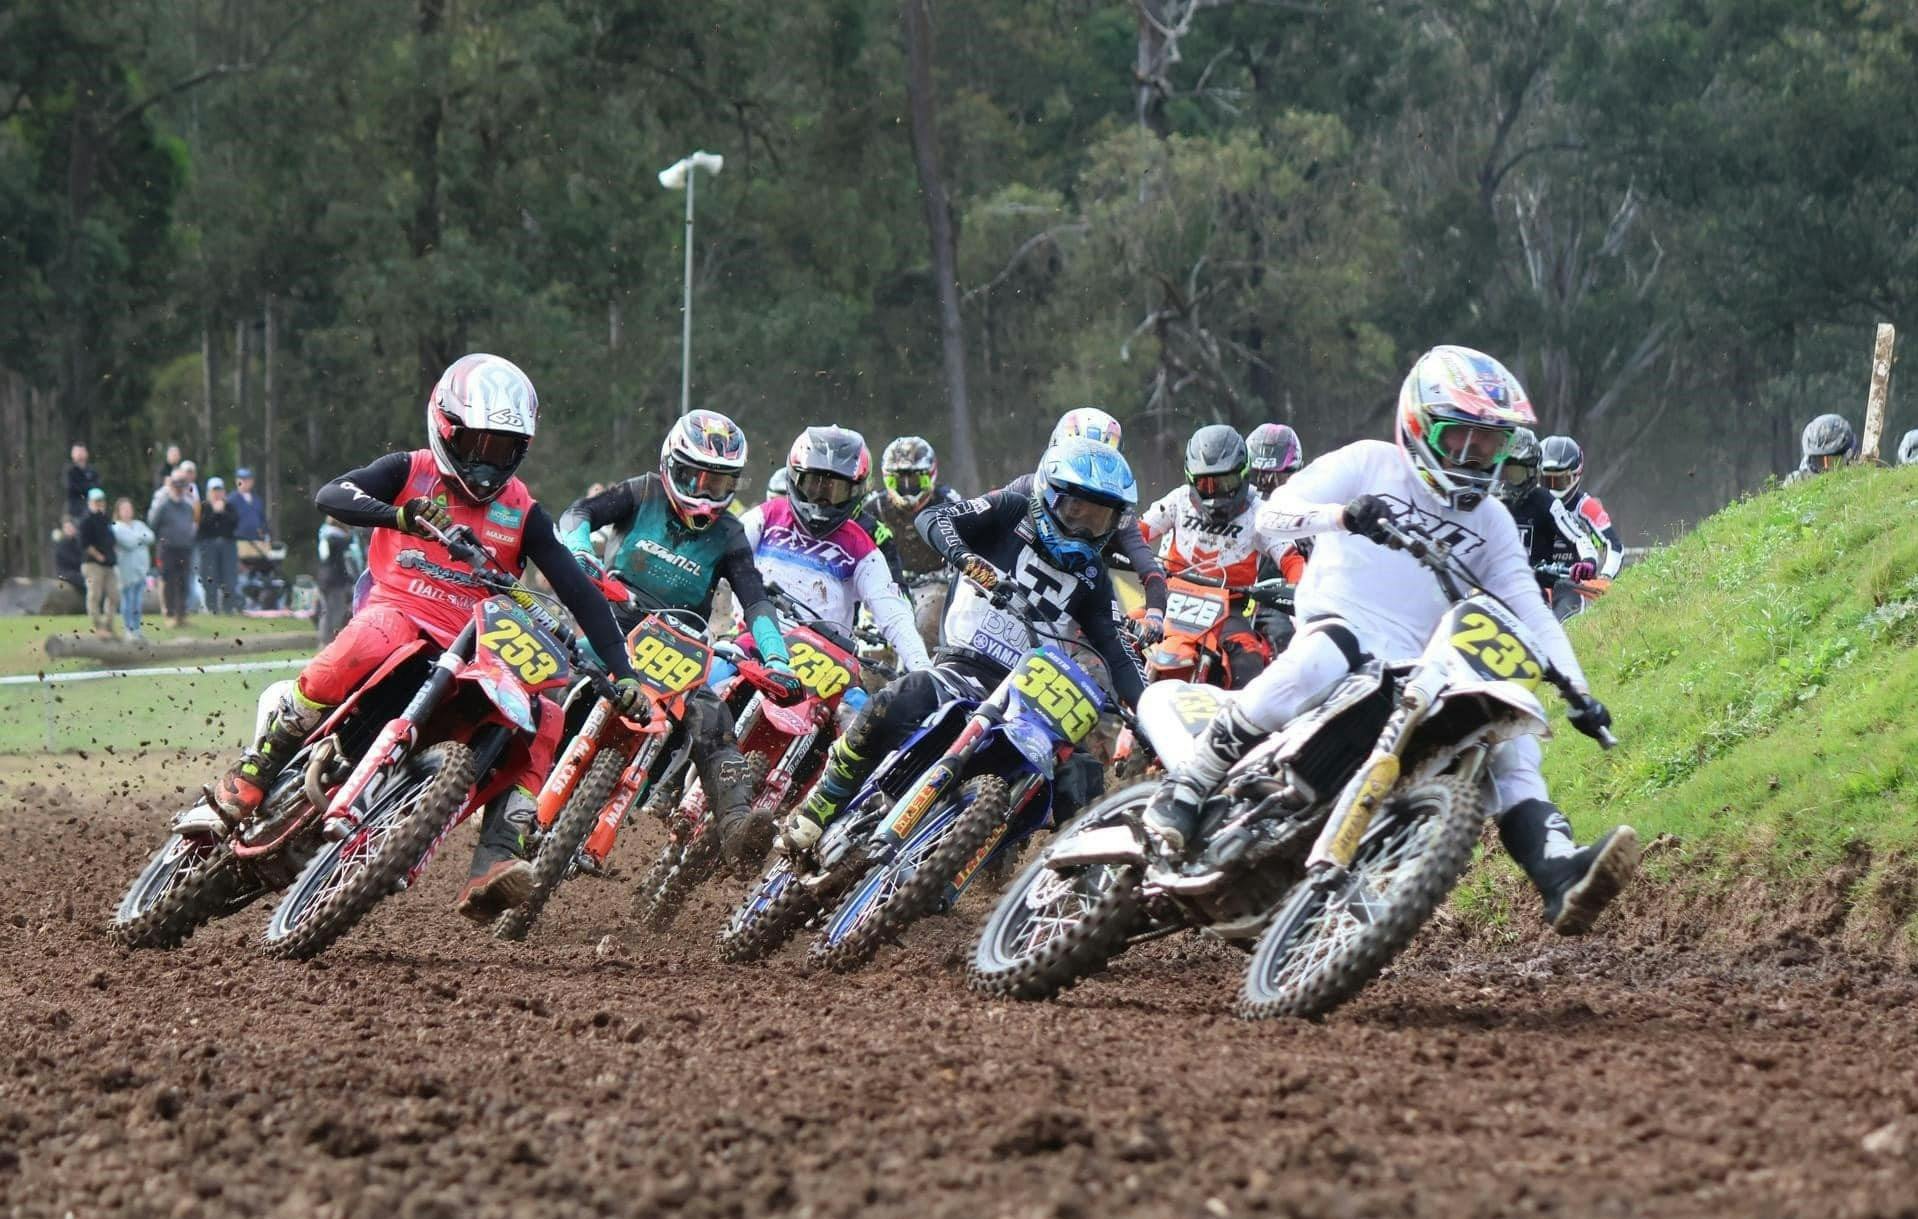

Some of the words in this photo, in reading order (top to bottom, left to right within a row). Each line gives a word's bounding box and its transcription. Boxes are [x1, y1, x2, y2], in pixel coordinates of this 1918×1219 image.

[1182, 515, 1243, 538] THOR
[480, 619, 558, 685] 253
[635, 636, 702, 692] 999
[1014, 657, 1099, 744] 355
